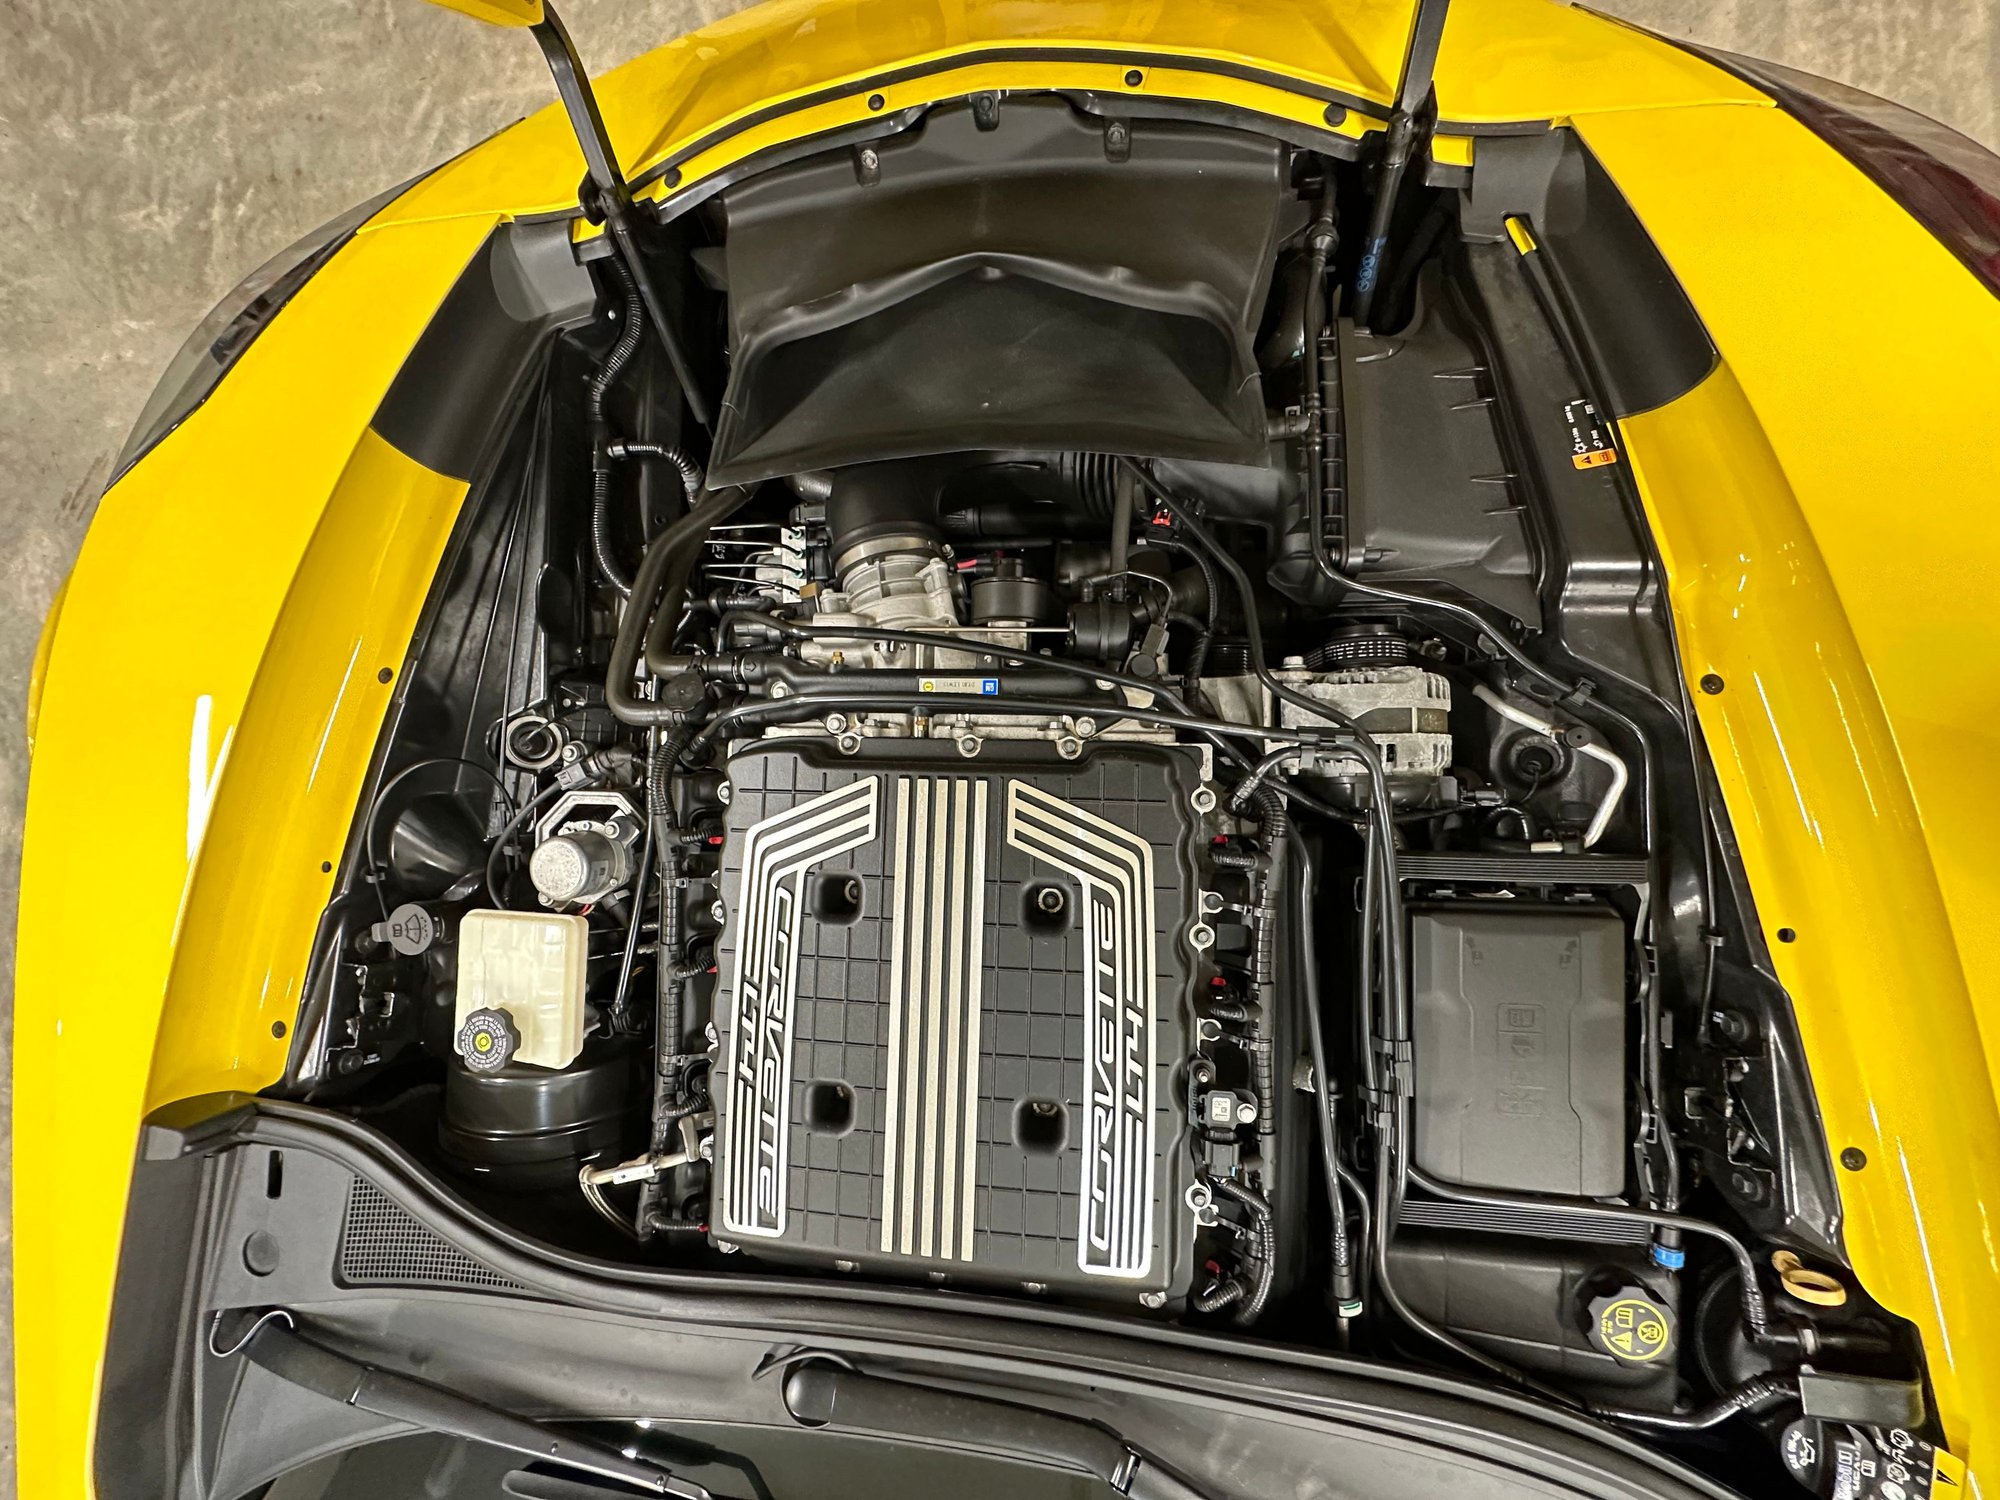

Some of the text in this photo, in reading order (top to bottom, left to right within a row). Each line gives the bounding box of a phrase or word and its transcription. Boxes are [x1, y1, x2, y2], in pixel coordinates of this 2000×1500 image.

[738, 979, 760, 1082] LT4
[759, 886, 792, 1219] CORVETTE
[1089, 898, 1116, 1252] CORVETTE
[1124, 1006, 1144, 1116] LT4
